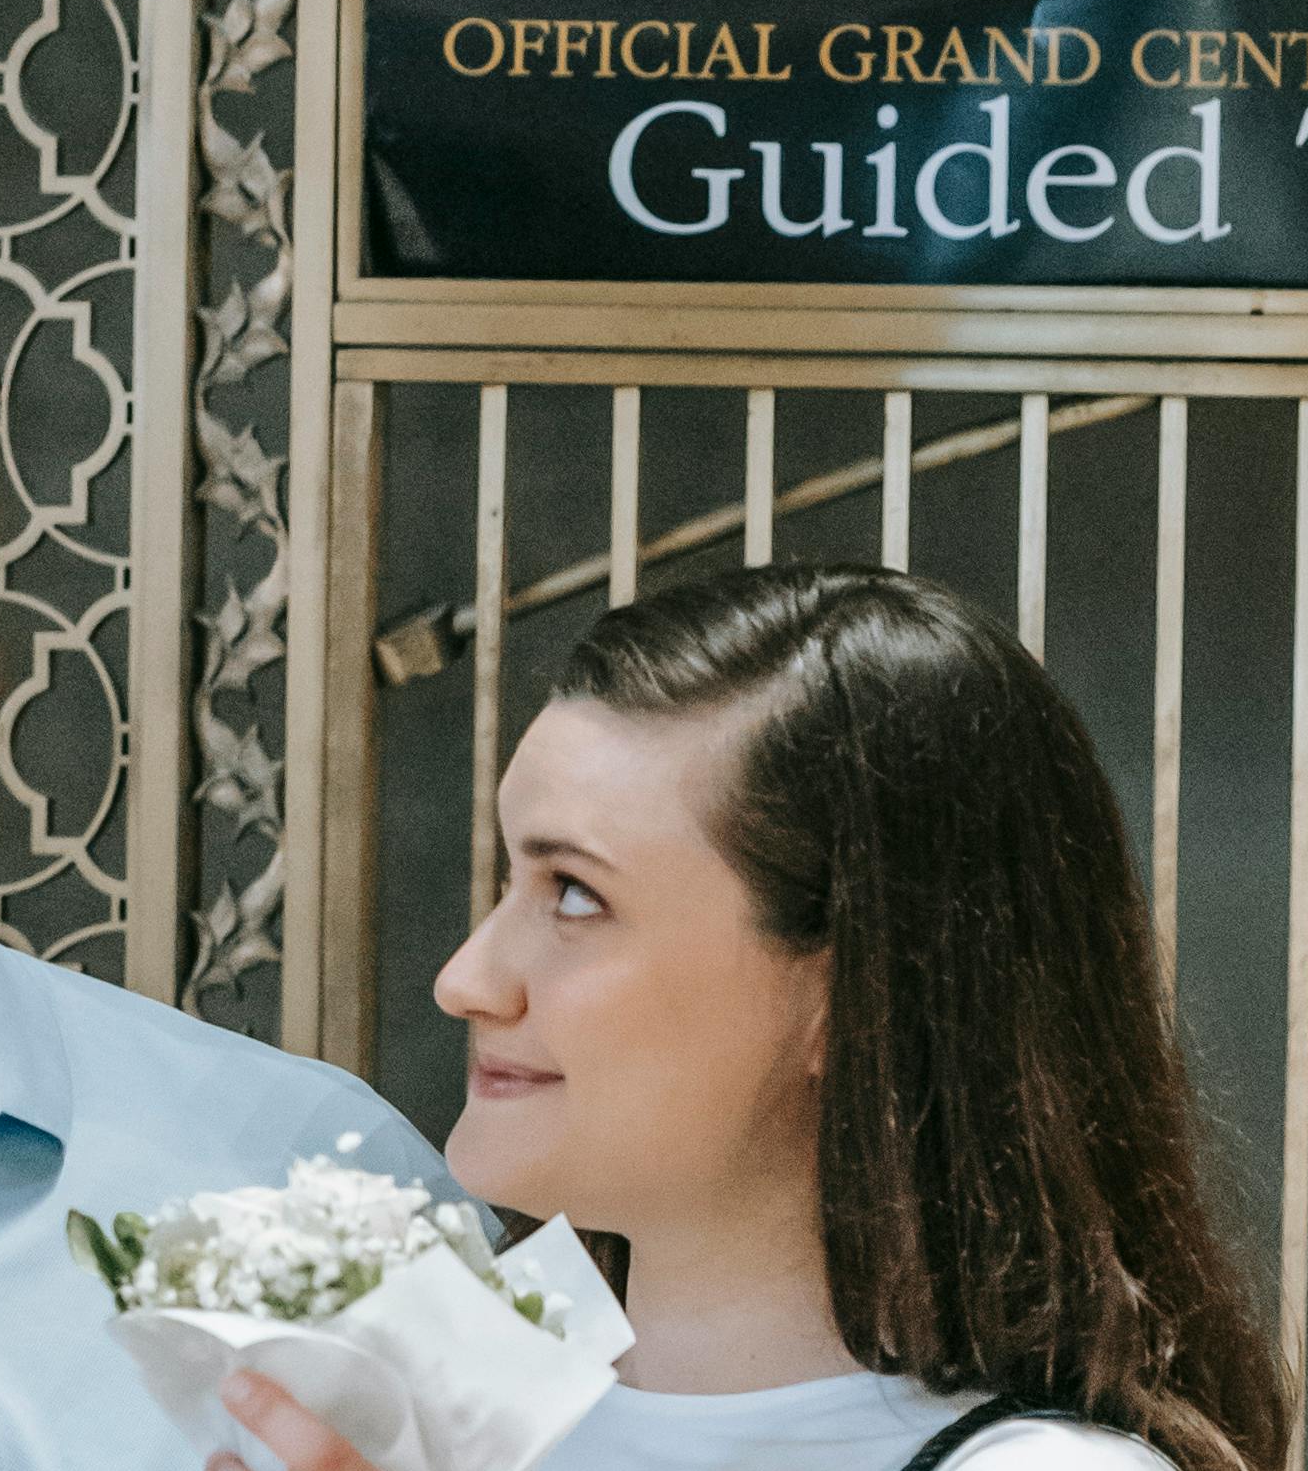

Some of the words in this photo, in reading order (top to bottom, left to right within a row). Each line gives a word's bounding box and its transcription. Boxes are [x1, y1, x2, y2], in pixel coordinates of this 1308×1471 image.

[443, 16, 792, 83] OFFICIAL
[818, 23, 1102, 87] GRAND
[607, 93, 1232, 244] Guided
